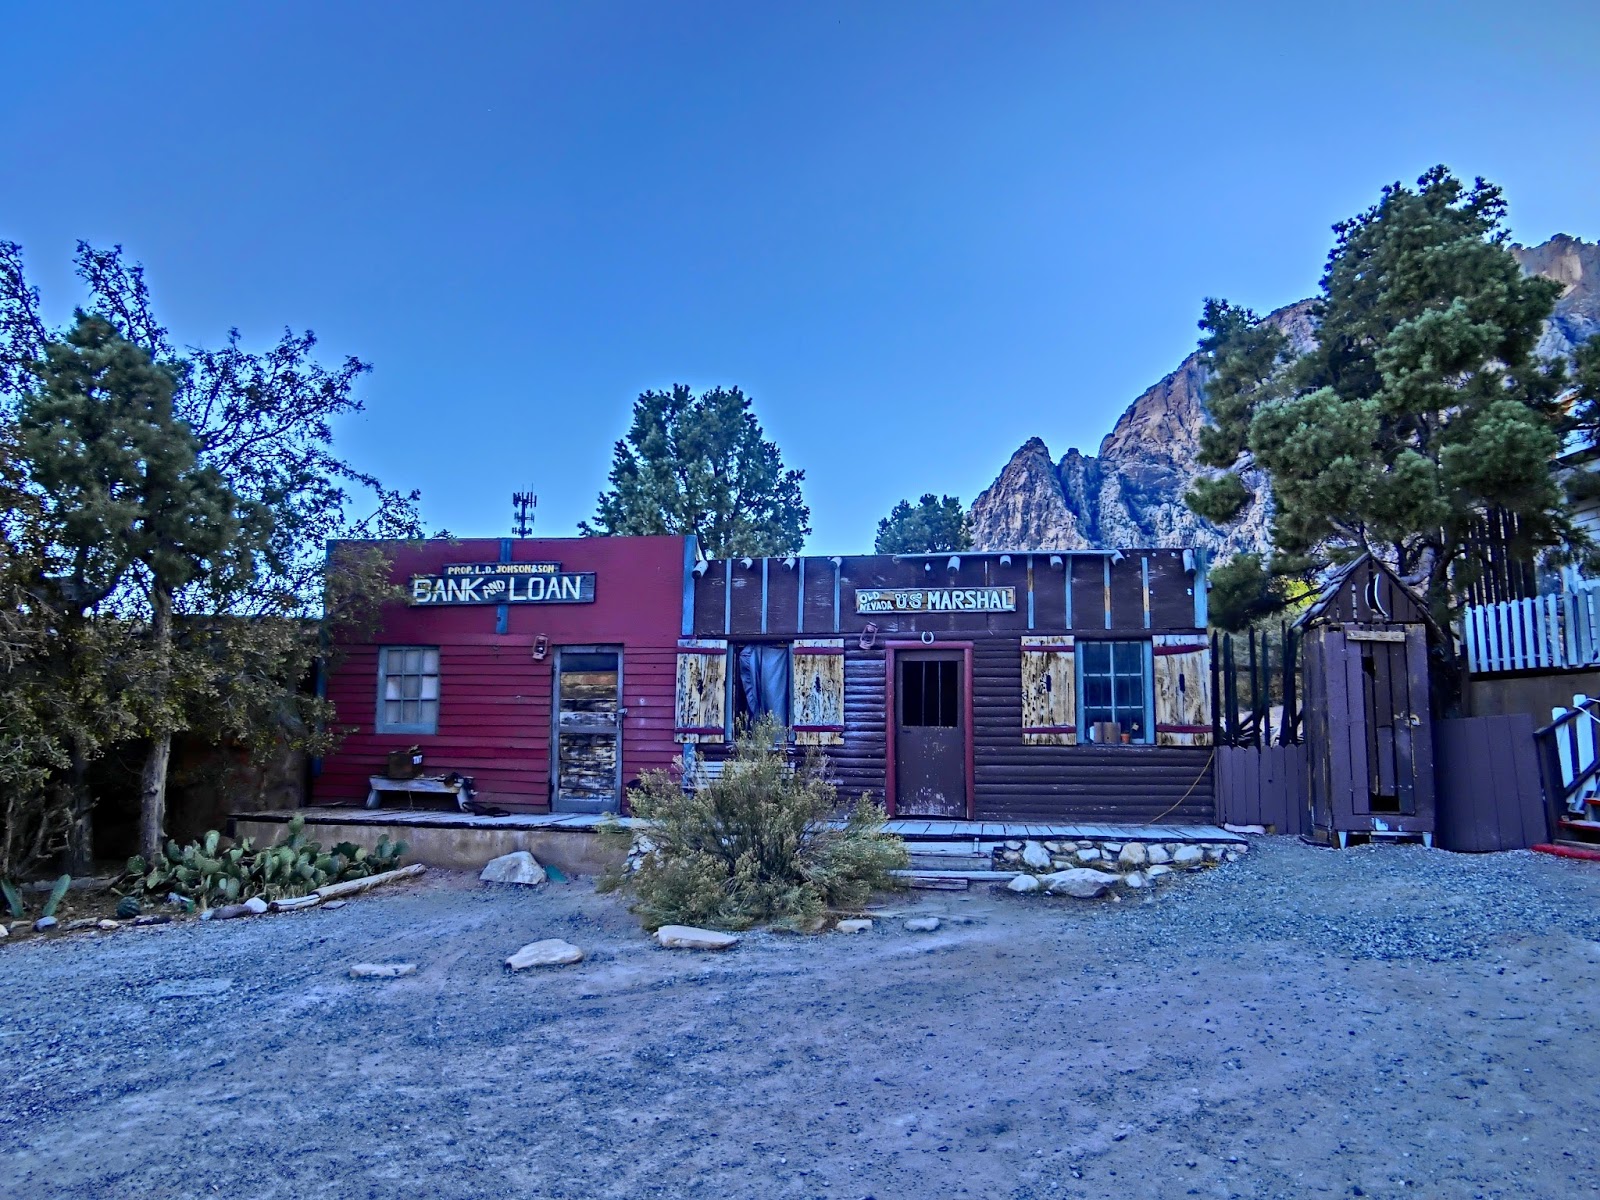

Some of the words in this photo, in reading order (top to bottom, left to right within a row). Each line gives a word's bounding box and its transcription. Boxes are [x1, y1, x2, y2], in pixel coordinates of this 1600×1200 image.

[448, 566, 475, 575] PROP.
[412, 577, 484, 602] BANK
[482, 580, 506, 599] AND
[509, 576, 581, 601] LOAN
[859, 591, 880, 604] OLD
[927, 590, 1014, 610] MARSHAL
[859, 600, 894, 611] NEVADA
